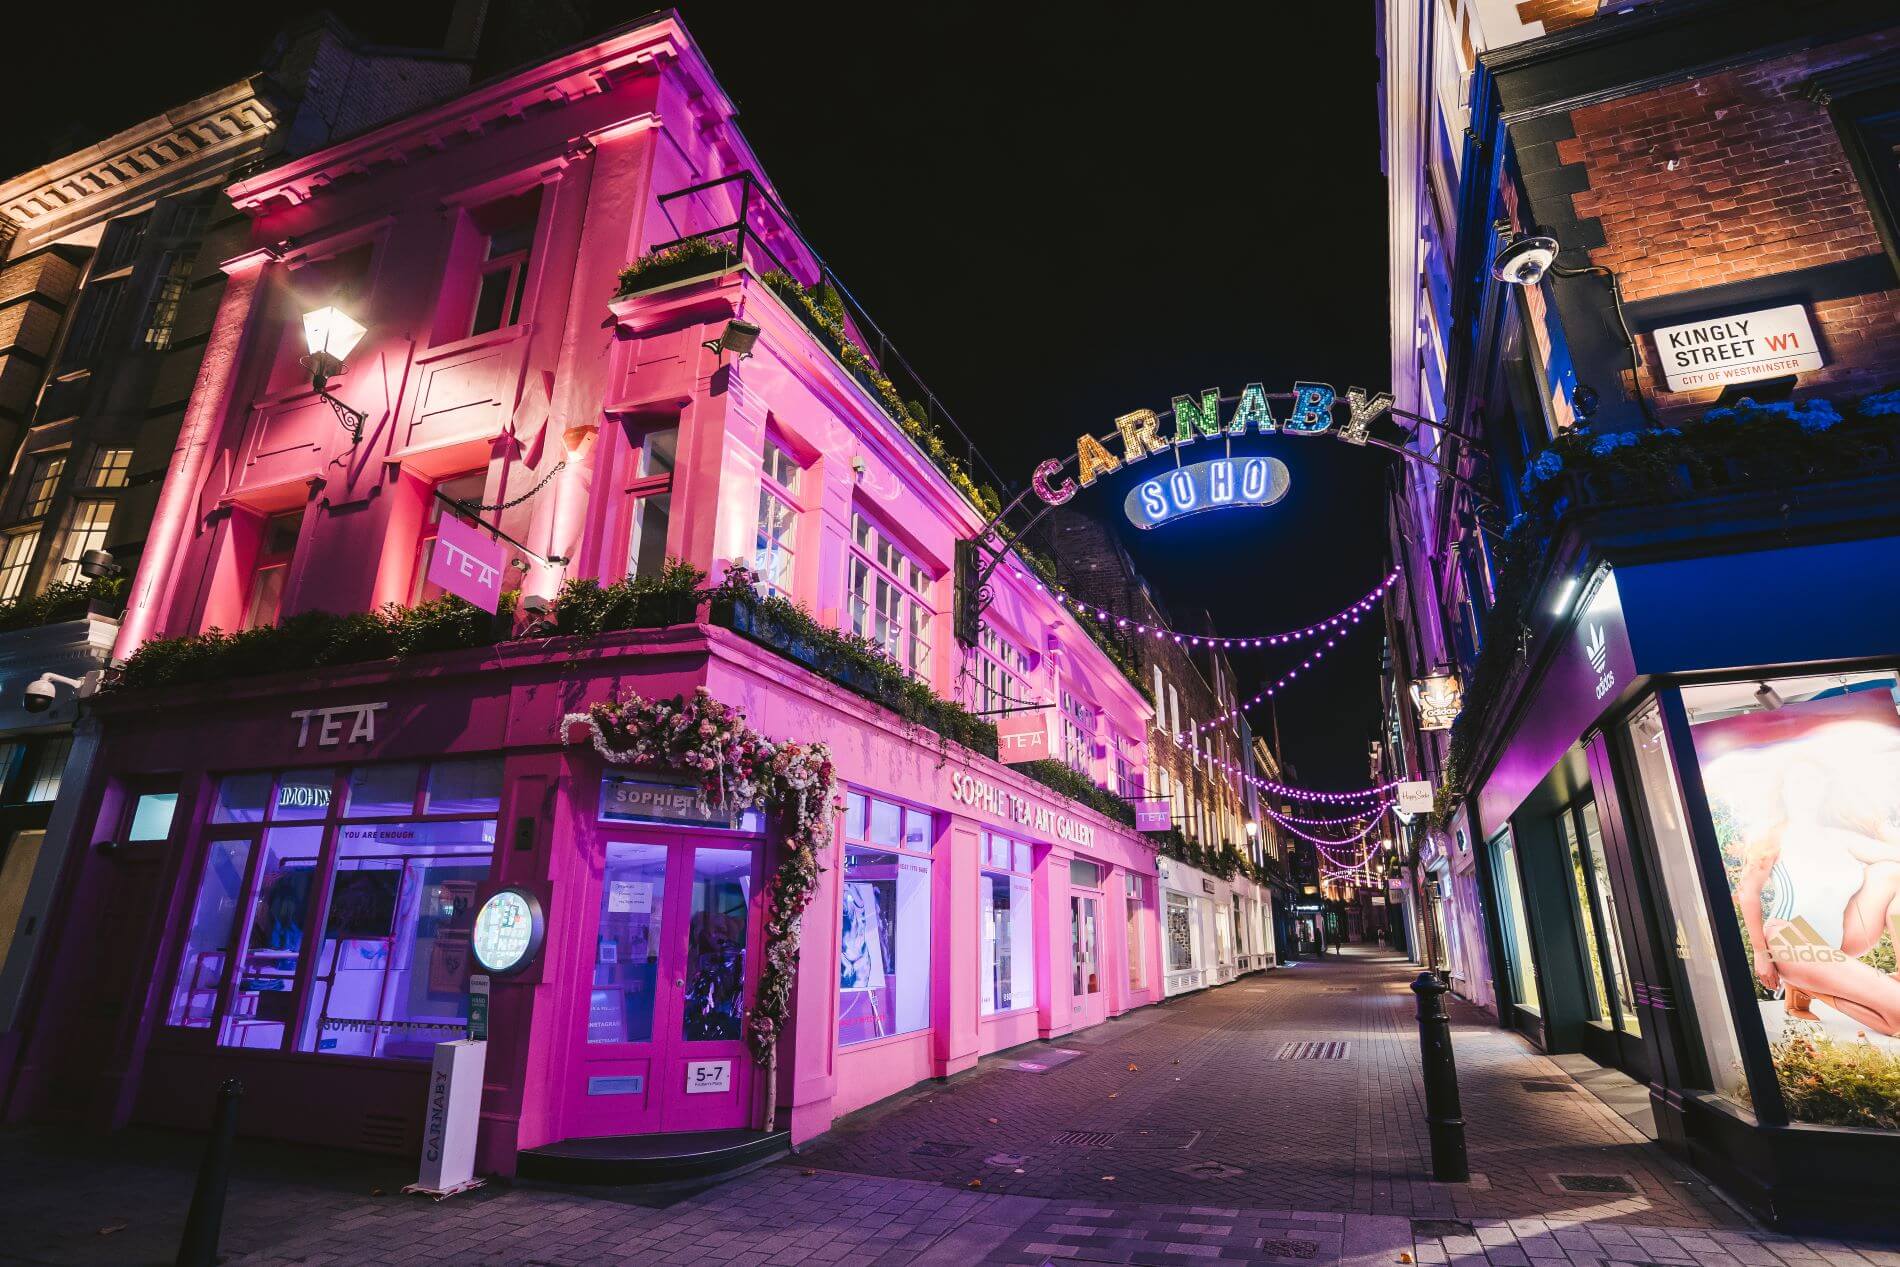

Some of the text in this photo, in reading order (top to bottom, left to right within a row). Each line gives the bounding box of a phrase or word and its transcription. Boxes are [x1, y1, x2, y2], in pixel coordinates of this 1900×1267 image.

[1669, 320, 1749, 348] KINGLY
[1675, 332, 1799, 367] STREET W1
[1682, 359, 1800, 385] CITY OF WESTMINSTER
[1032, 381, 1395, 506] CARNABY
[1141, 458, 1268, 519] SOHO
[440, 538, 500, 589] TEA
[1596, 670, 1615, 700] adidas
[291, 701, 388, 748] TEA
[1002, 730, 1045, 749] TEA
[952, 769, 1095, 848] SOPHIE TEA ART GALLERY
[1138, 812, 1168, 822] TEA
[1765, 946, 1847, 963] adidas
[696, 1066, 723, 1081] 5-7
[426, 1071, 447, 1162] CARNABY
